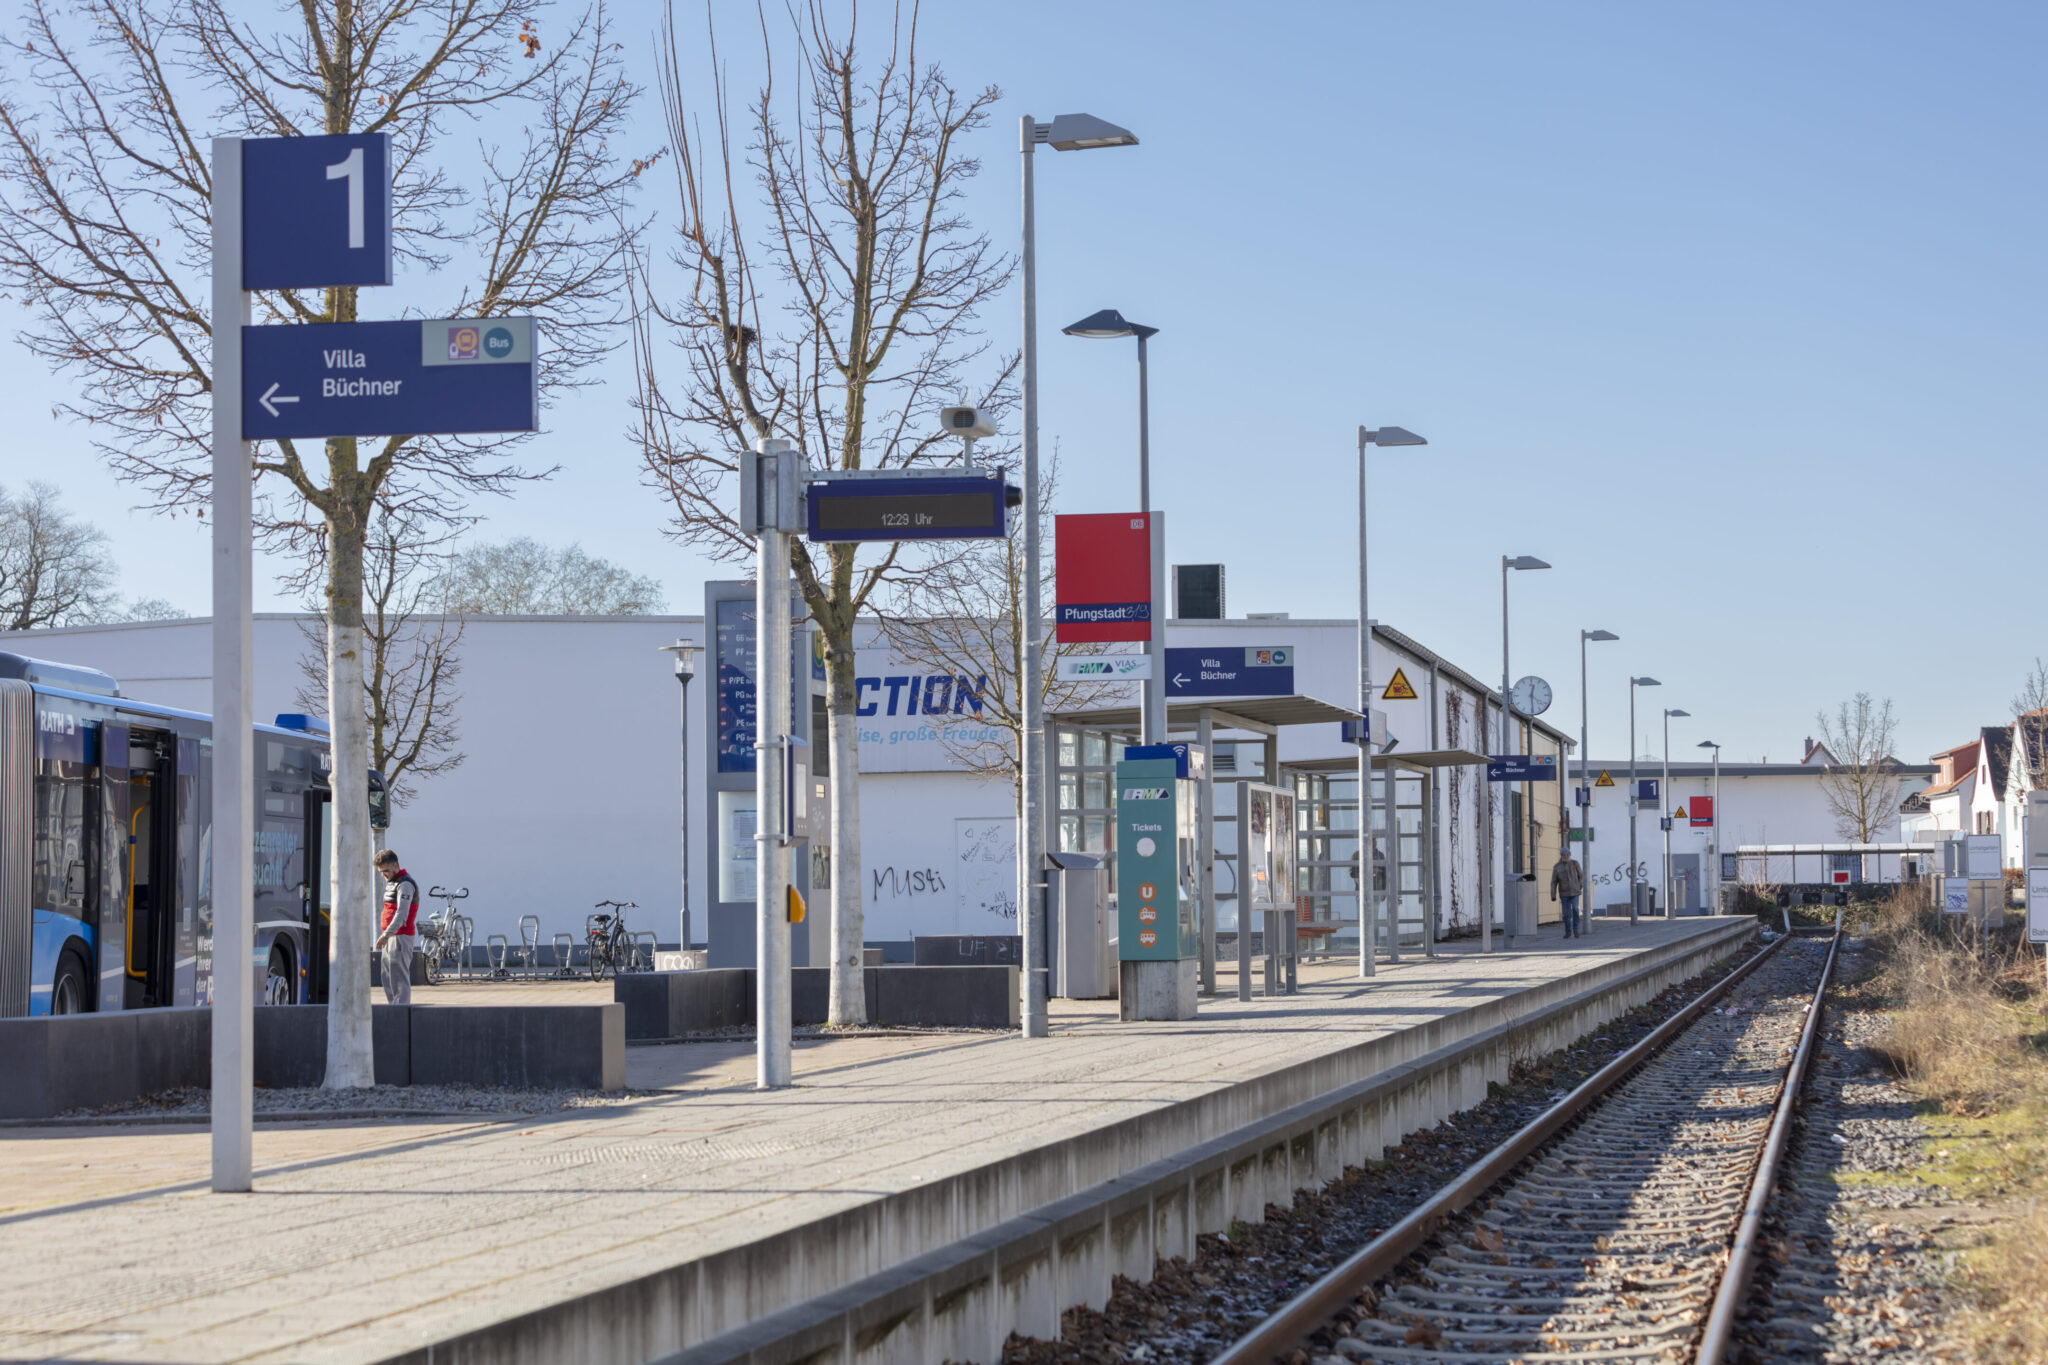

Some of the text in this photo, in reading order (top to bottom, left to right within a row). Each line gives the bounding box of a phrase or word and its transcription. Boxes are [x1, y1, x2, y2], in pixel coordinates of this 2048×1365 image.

[326, 148, 364, 248] 1
[489, 337, 510, 348] Bus
[323, 350, 366, 369] Villa
[322, 377, 402, 398] Büchner
[881, 513, 933, 526] 12:29 Uhr
[1065, 608, 1126, 622] Pfungstadt
[1115, 659, 1137, 667] VIAS
[1201, 659, 1220, 668] Villa
[1200, 670, 1237, 680] Büchner
[729, 677, 745, 685] P/PE
[735, 691, 745, 699] PG
[740, 705, 745, 713] P
[40, 710, 65, 735] RATH
[736, 719, 745, 727] PE
[735, 733, 745, 742] PG
[889, 726, 937, 745] große
[942, 726, 999, 742] Freude
[1650, 781, 1657, 796] 1
[1131, 823, 1162, 832] Tickets
[1142, 886, 1153, 898] U
